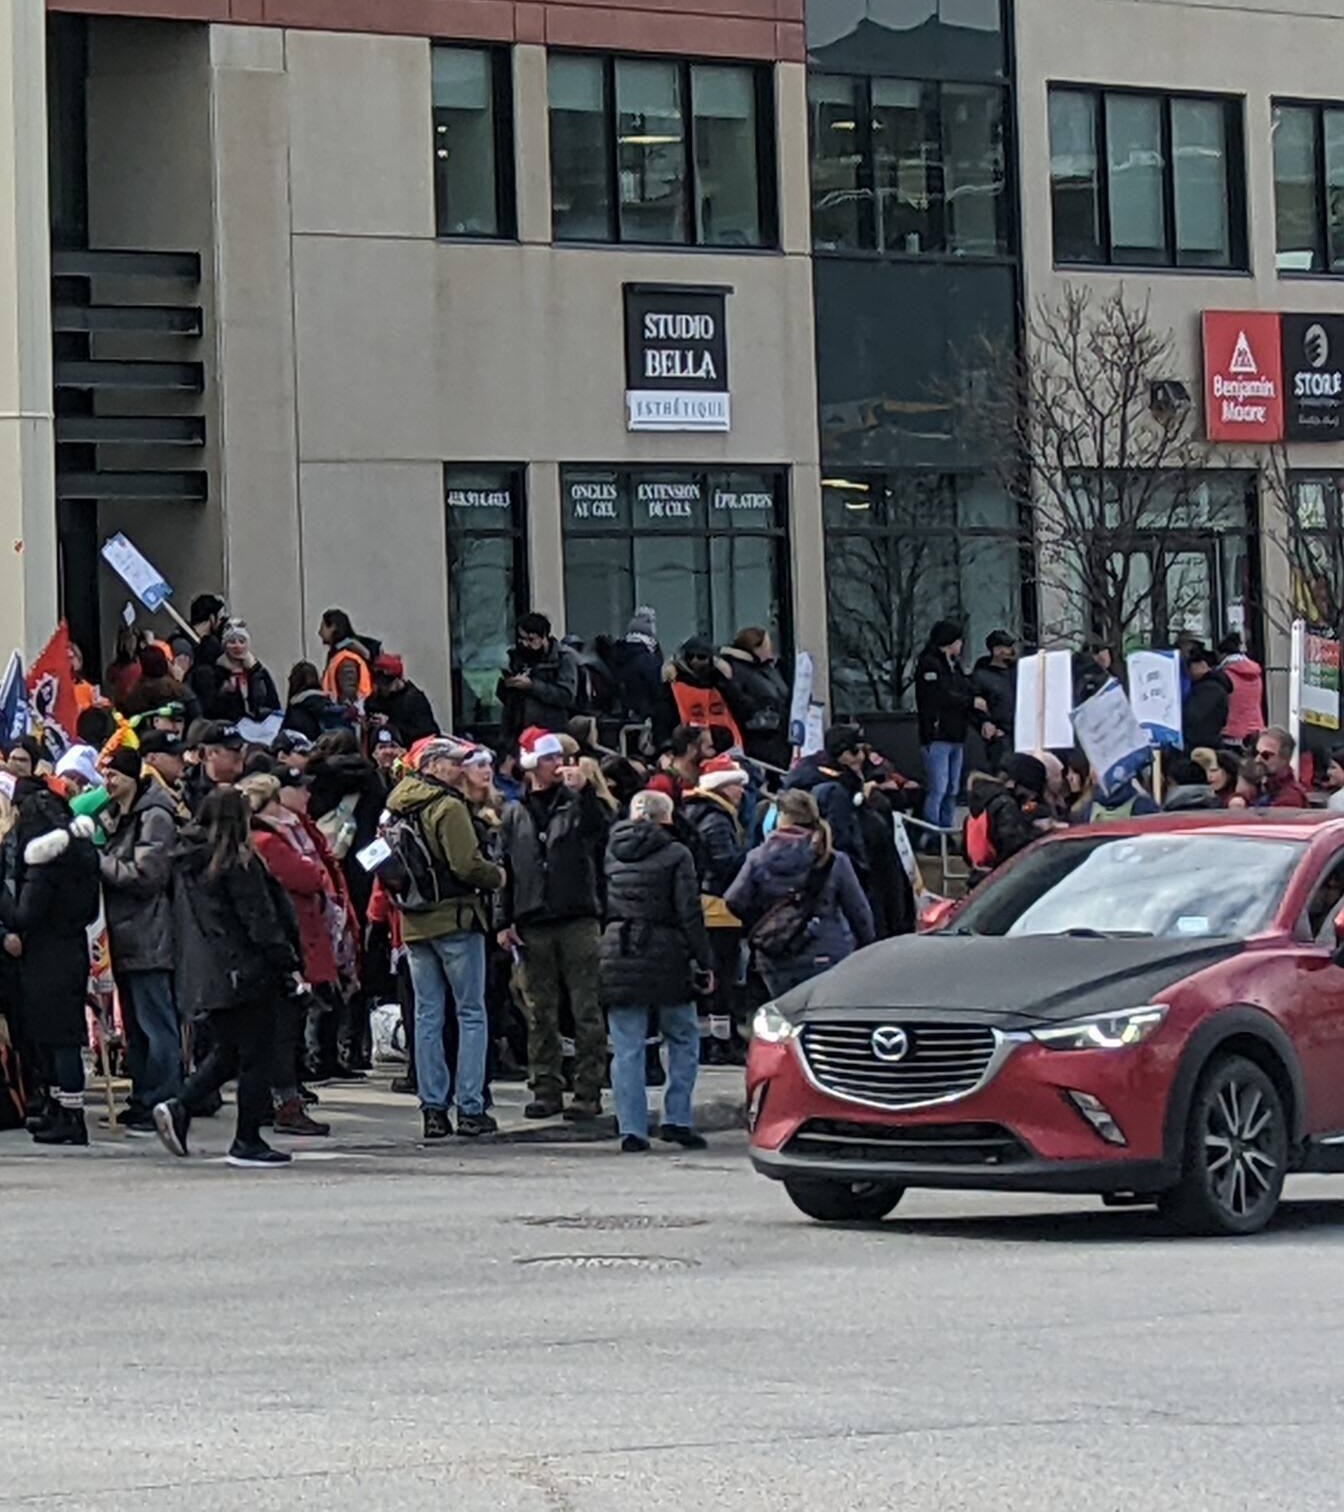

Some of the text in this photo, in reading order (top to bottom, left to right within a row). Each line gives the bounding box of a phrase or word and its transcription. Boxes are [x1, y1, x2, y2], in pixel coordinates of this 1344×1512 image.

[644, 313, 714, 339] STUDIO
[645, 348, 716, 379] BELLA
[1213, 375, 1275, 402] Benjamin
[1294, 371, 1342, 397] STORE
[637, 397, 725, 419] ESTHÉTIQUE
[1221, 400, 1267, 424] Moore
[571, 484, 617, 499] ONGLES
[637, 484, 700, 500] EXTENSION
